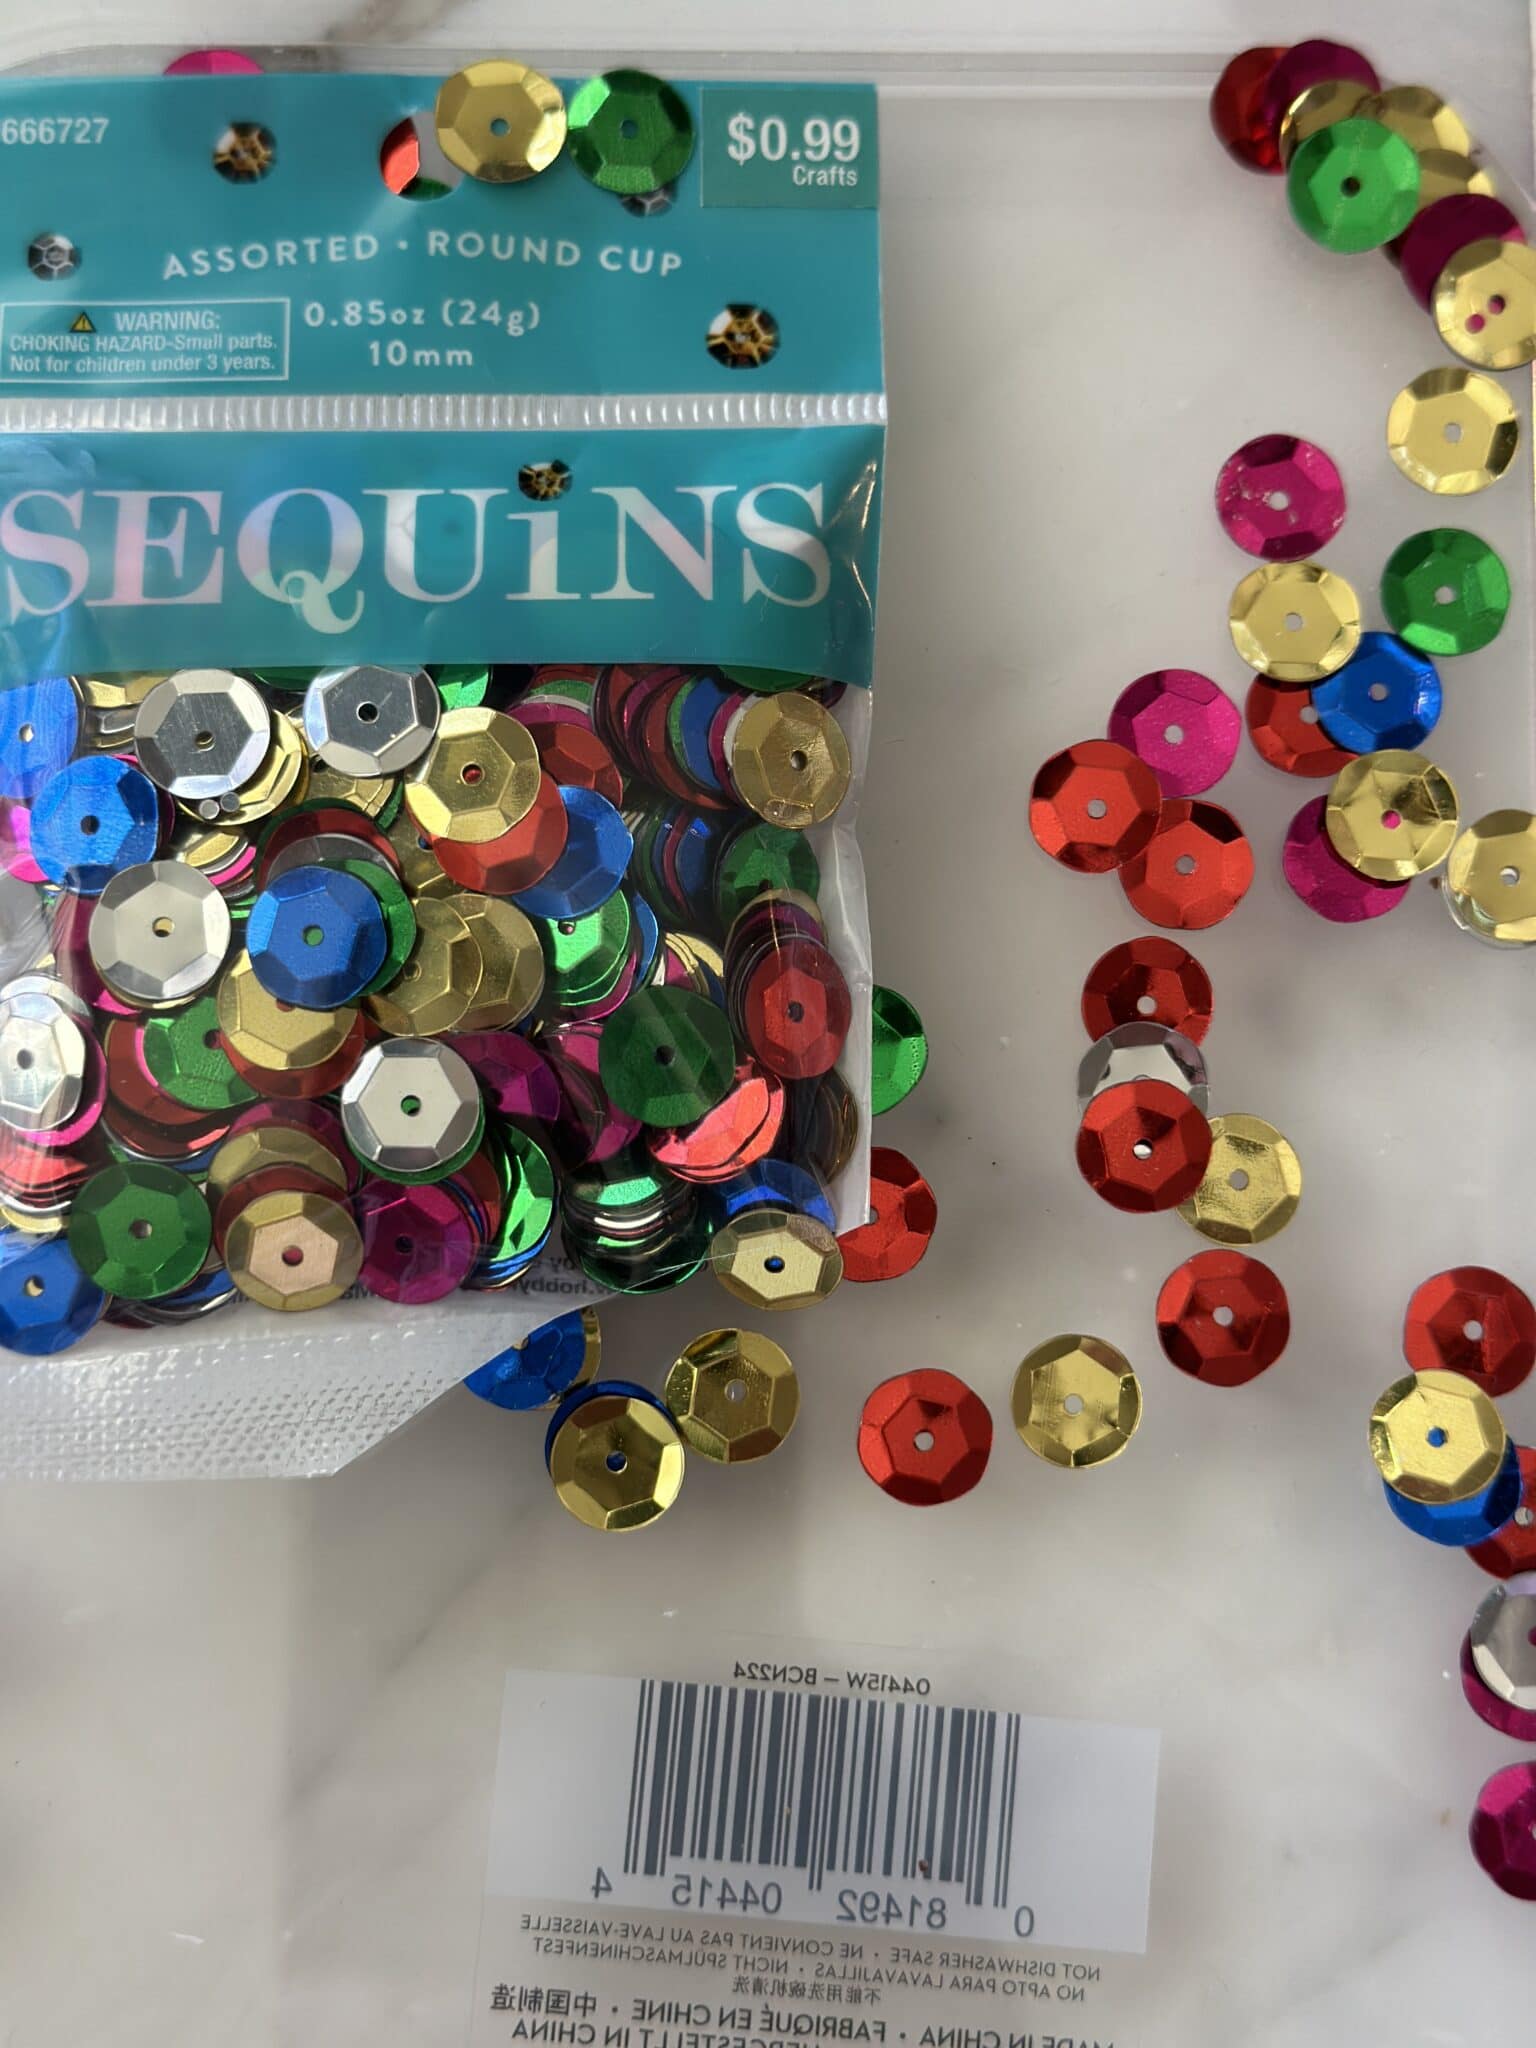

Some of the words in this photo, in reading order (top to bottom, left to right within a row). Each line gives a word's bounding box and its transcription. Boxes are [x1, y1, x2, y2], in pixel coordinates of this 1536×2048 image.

[727, 111, 860, 166] $0.99
[792, 165, 858, 186] Crafts
[162, 233, 379, 280] ASSORTED
[428, 230, 581, 266] ROUND
[599, 246, 683, 276] CUP
[115, 312, 221, 332] WARNING:
[304, 301, 425, 328] 0.85oz
[440, 301, 541, 337] (24g)
[10, 335, 90, 352] CHOKING
[229, 333, 277, 350] parts.
[369, 340, 473, 367] 10mm
[11, 357, 40, 373] Not
[46, 356, 71, 372] for
[75, 355, 146, 373] children
[152, 354, 202, 372] under
[207, 354, 218, 370] 3
[223, 353, 275, 372] years.
